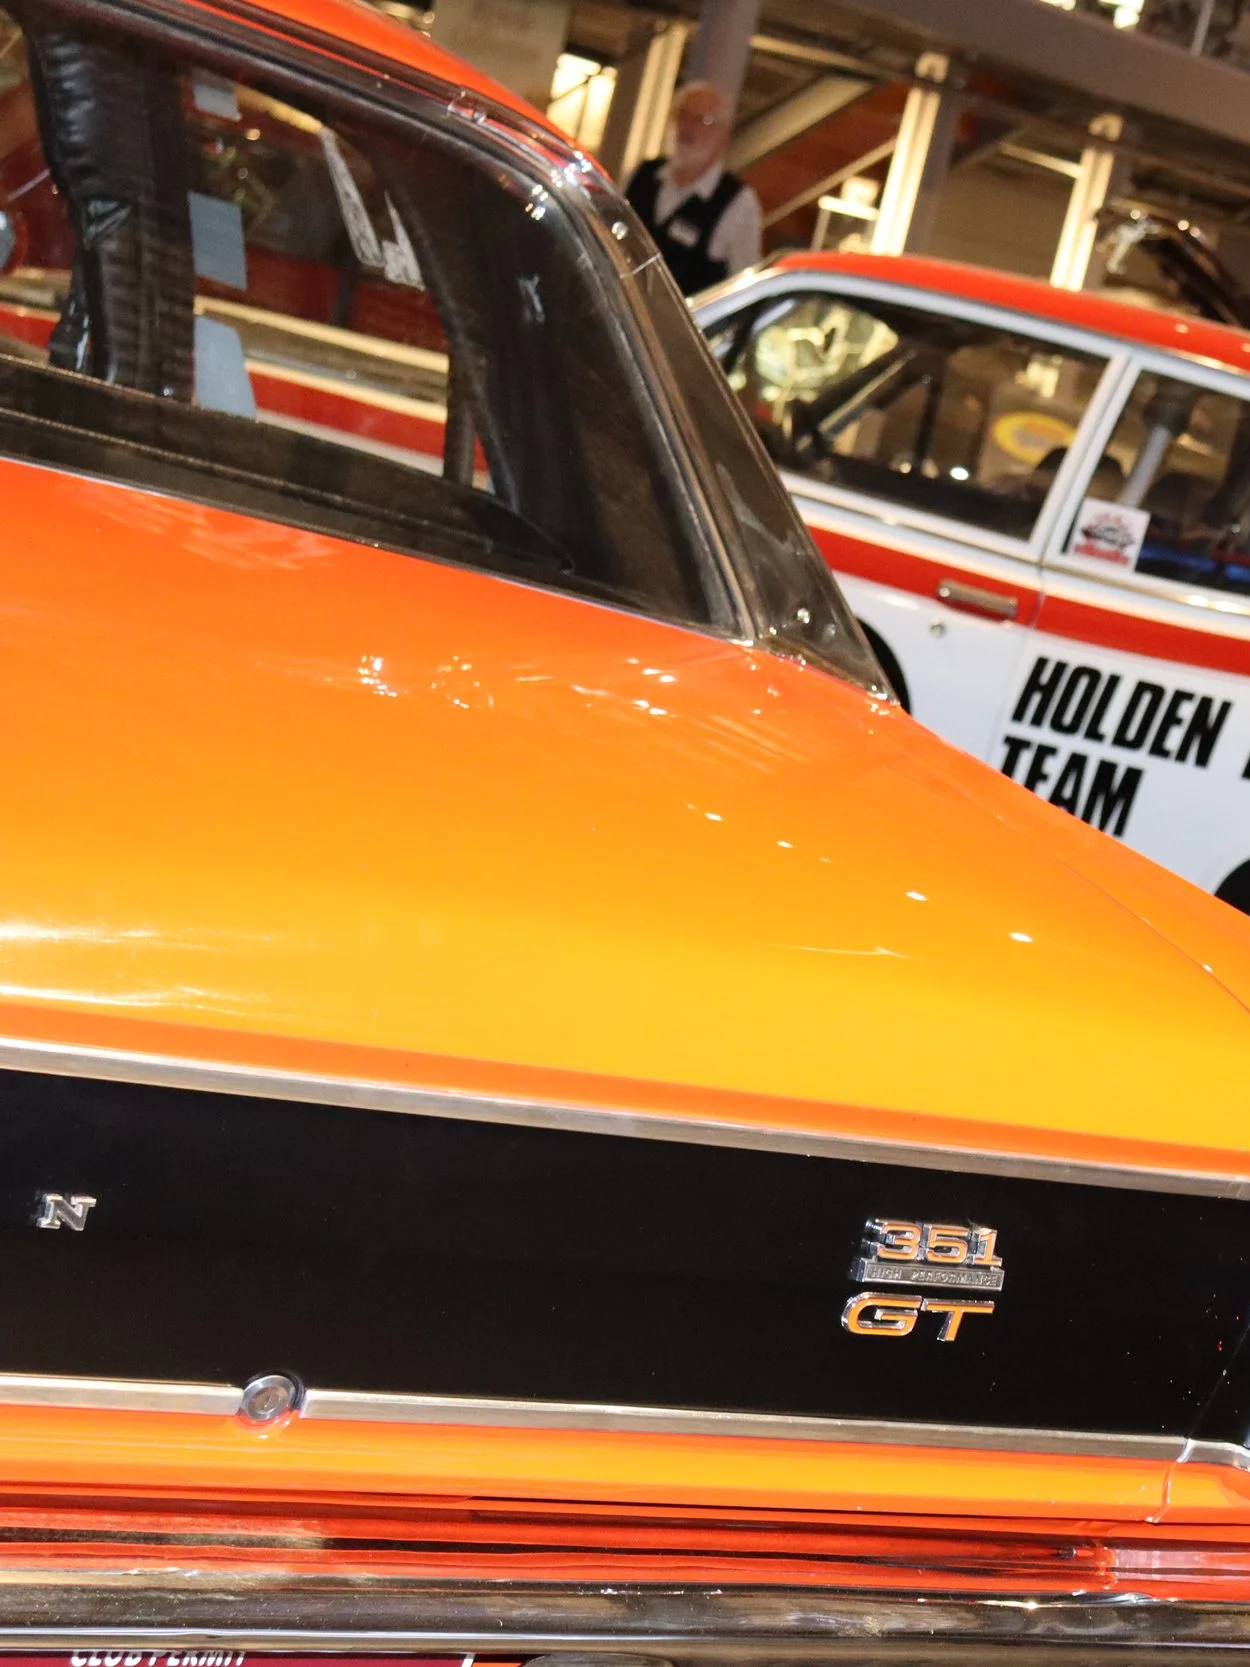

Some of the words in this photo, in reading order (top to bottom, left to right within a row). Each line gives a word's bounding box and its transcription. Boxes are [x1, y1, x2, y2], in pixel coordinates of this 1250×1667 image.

[1011, 656, 1234, 768] HOLDEN
[1000, 736, 1144, 838] TEAM
[36, 1193, 97, 1231] N
[864, 1219, 1002, 1266] 351
[870, 1265, 902, 1280] HIGH
[911, 1269, 999, 1287] PERFORMANCE
[841, 1292, 996, 1341] GT
